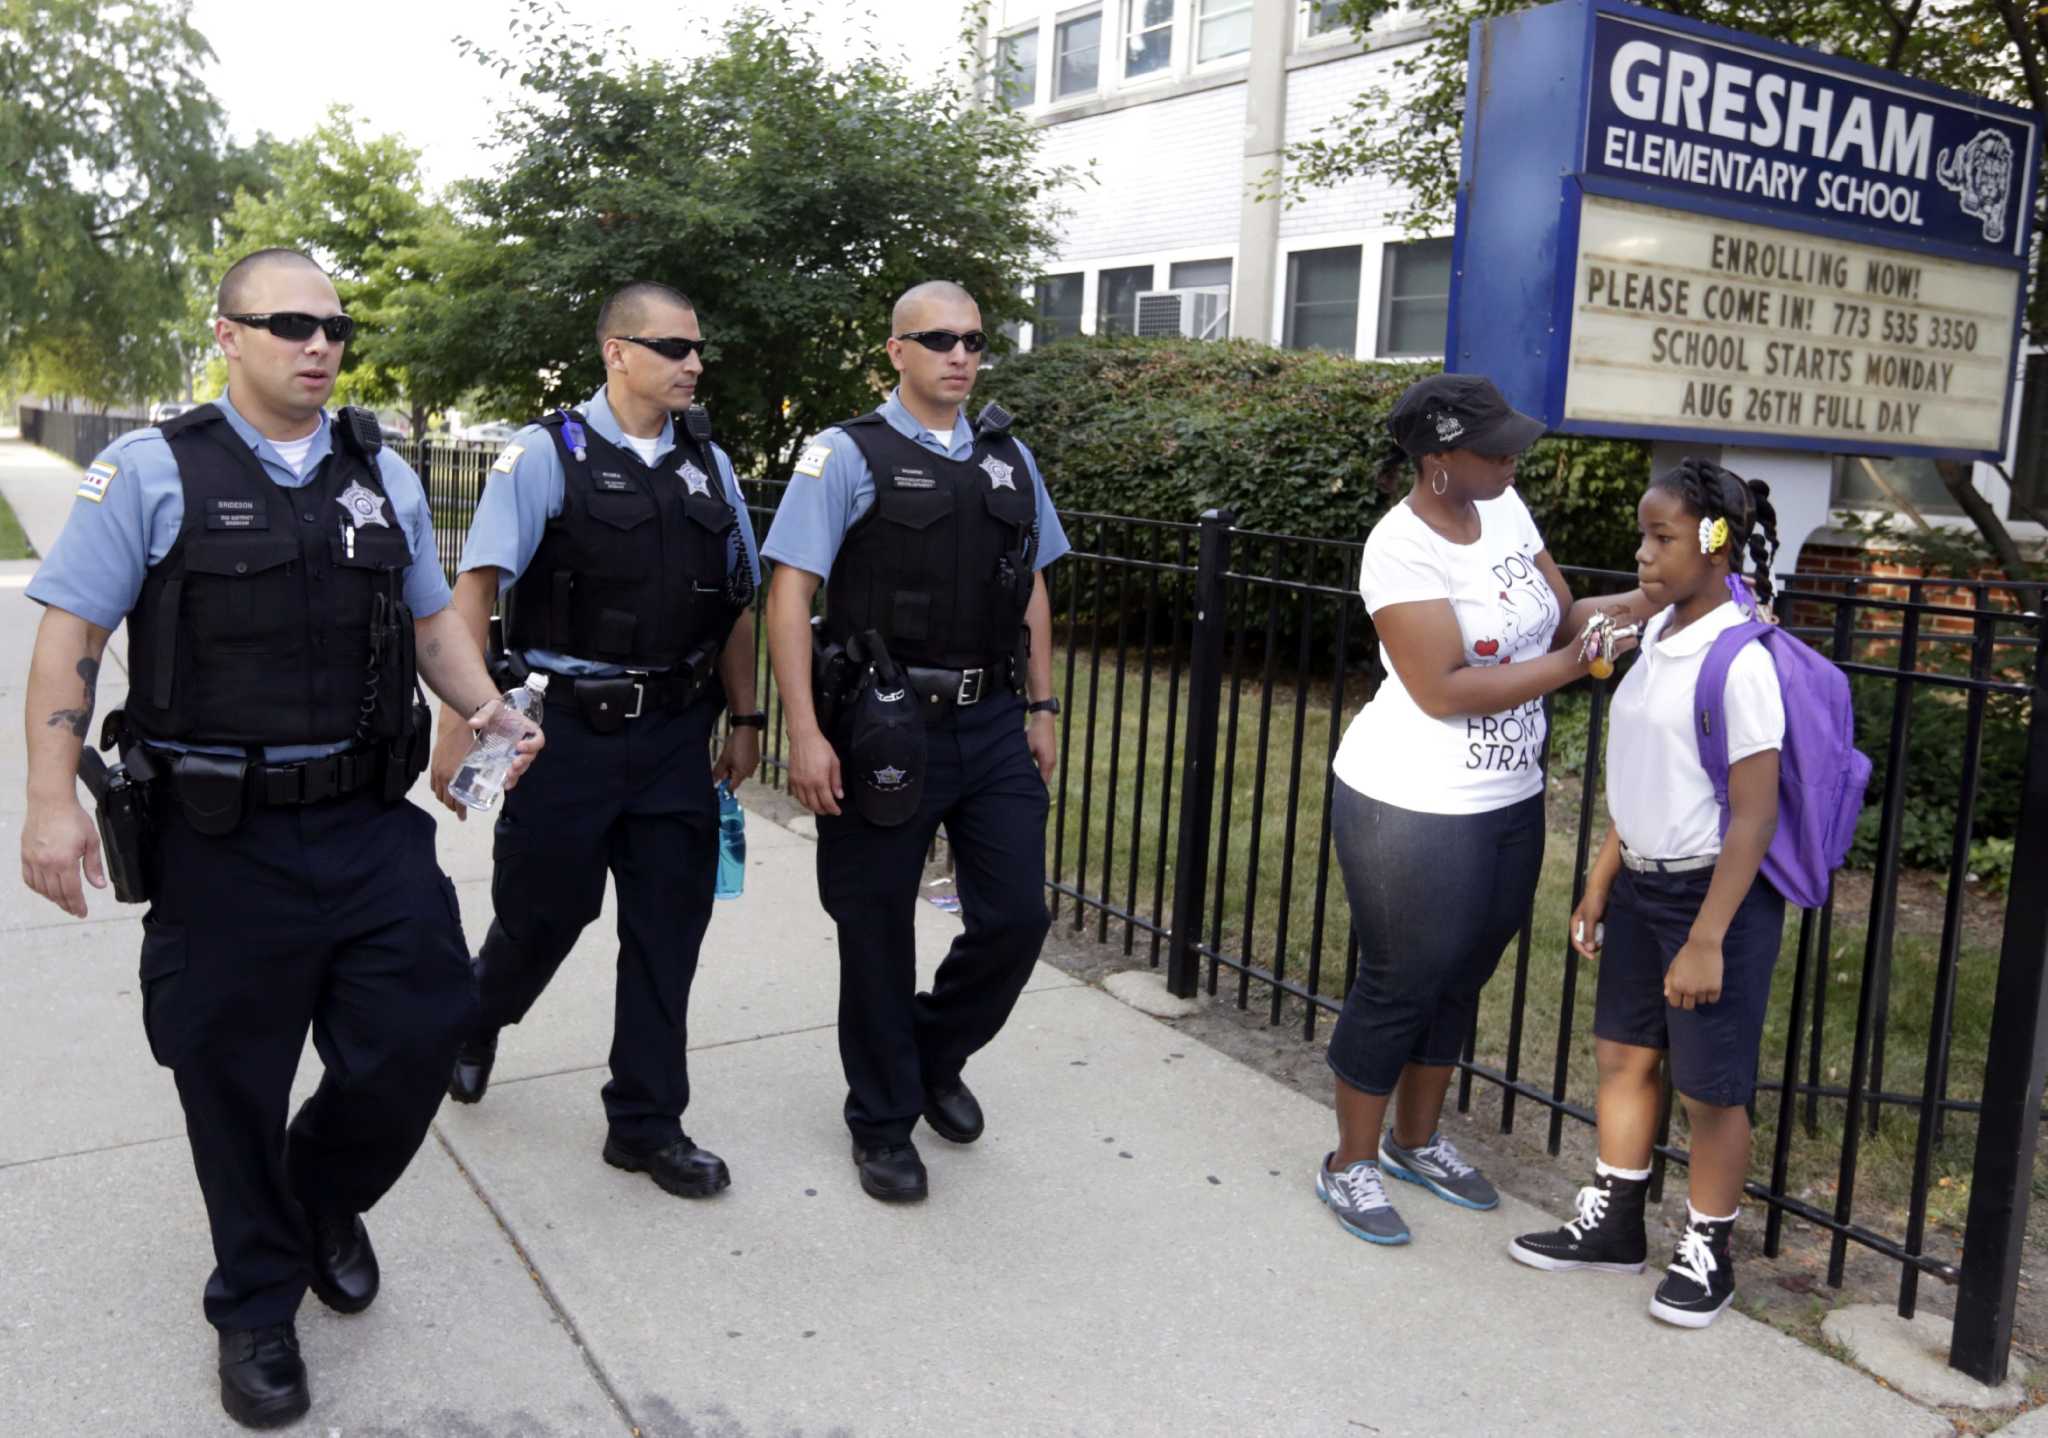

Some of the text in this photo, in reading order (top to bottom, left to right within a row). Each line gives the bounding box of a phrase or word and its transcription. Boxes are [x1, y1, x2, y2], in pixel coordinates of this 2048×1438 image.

[1610, 40, 1935, 181] GRESHAM
[1603, 126, 1924, 226] ELEMENTARY SCHOOL
[1711, 234, 1922, 300] ENROLLING NOW!
[1588, 266, 1978, 352] PLEASE COME IN! 773 535 3350
[1651, 327, 1954, 394] SCHOOL STARTS MONDAY
[1681, 381, 1921, 434] AUG 26TH FULL DAY
[1466, 716, 1538, 742] FROM
